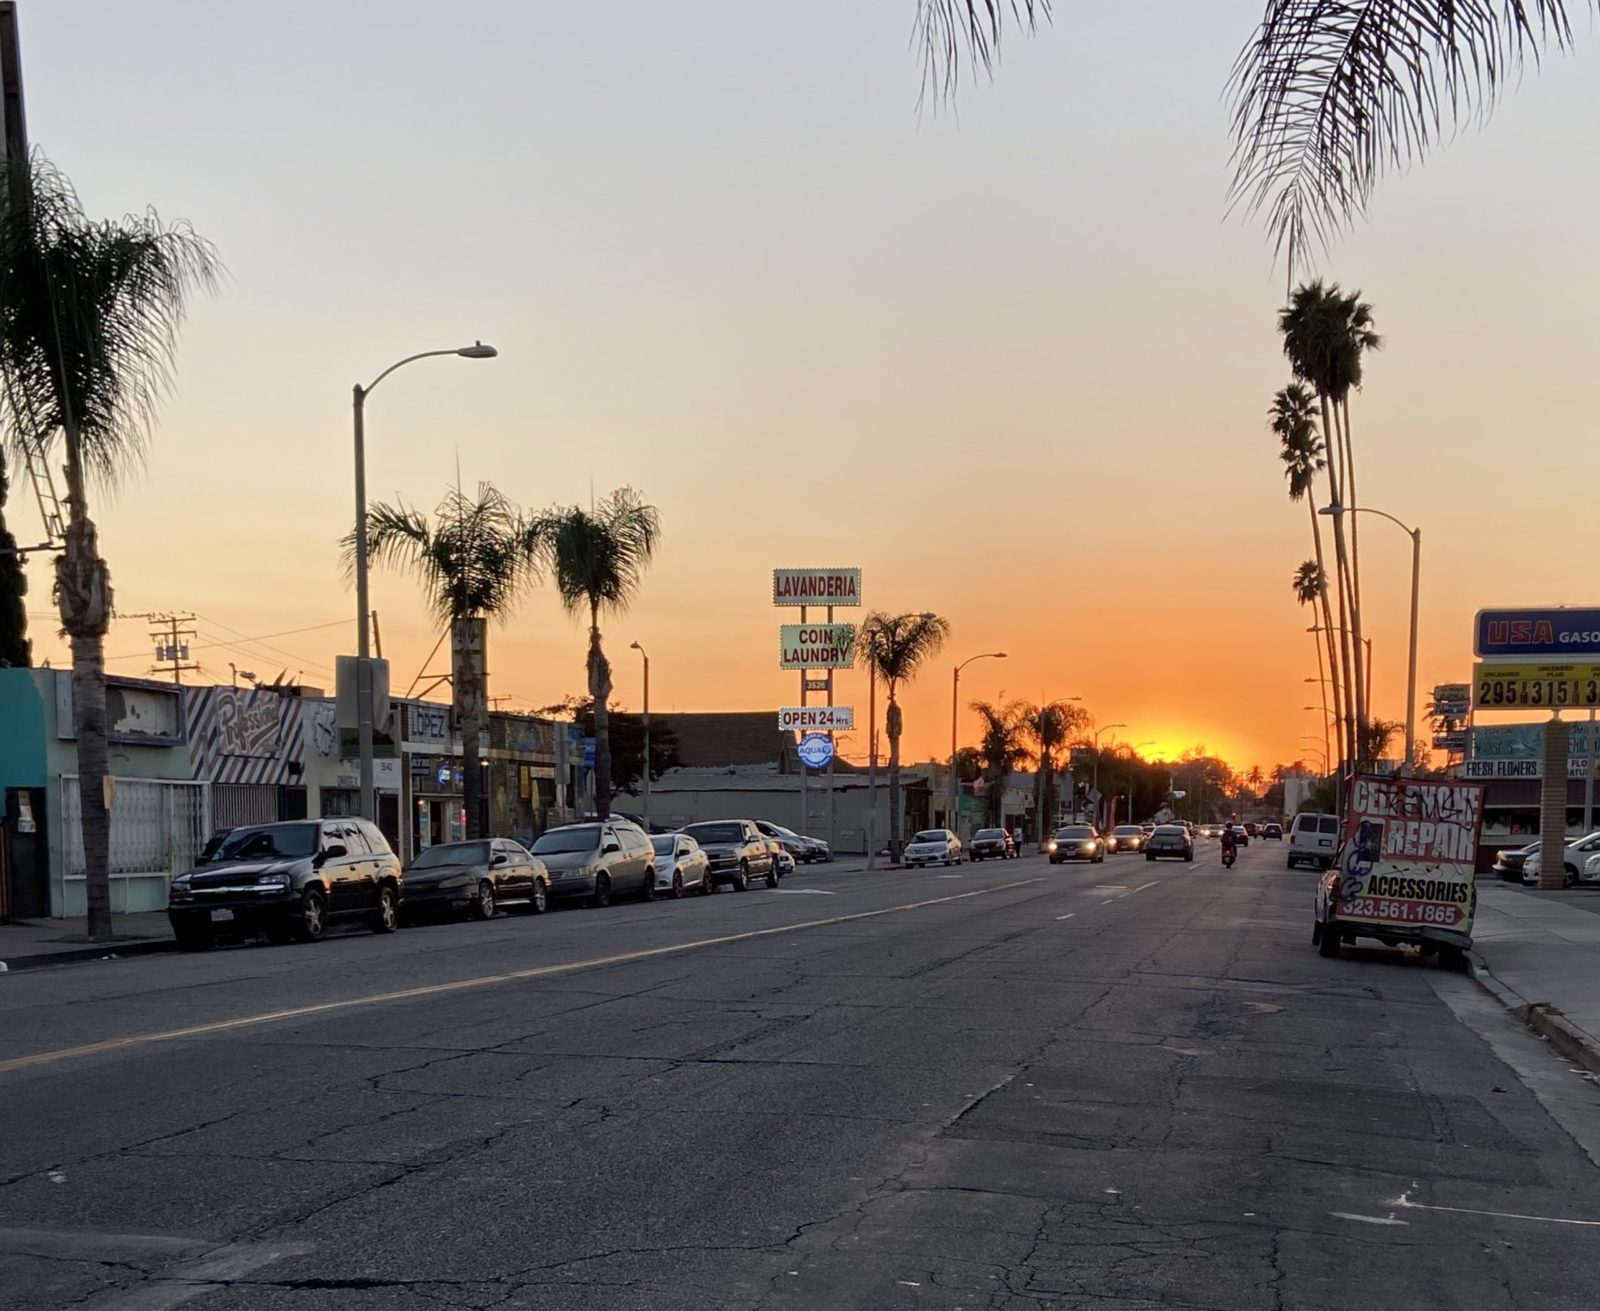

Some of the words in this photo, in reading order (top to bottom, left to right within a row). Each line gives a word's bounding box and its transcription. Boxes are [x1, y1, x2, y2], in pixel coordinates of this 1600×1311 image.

[776, 576, 856, 597] LAVANDERIA
[799, 629, 833, 644] COIN
[1488, 620, 1553, 644] USA
[783, 647, 849, 663] LAUNDRY
[1480, 681, 1516, 704] 295
[1532, 681, 1567, 704] 315
[783, 711, 816, 725] OPEN
[819, 711, 834, 724] 24
[1466, 761, 1494, 776] FRESH
[1497, 761, 1537, 776] FLOWERS
[1353, 780, 1398, 816] CELL
[1404, 785, 1481, 822] PHONE
[1387, 819, 1475, 861] REPAIR
[1367, 875, 1468, 903] ACCESSORIES
[1343, 899, 1455, 922] 323.561.1865
